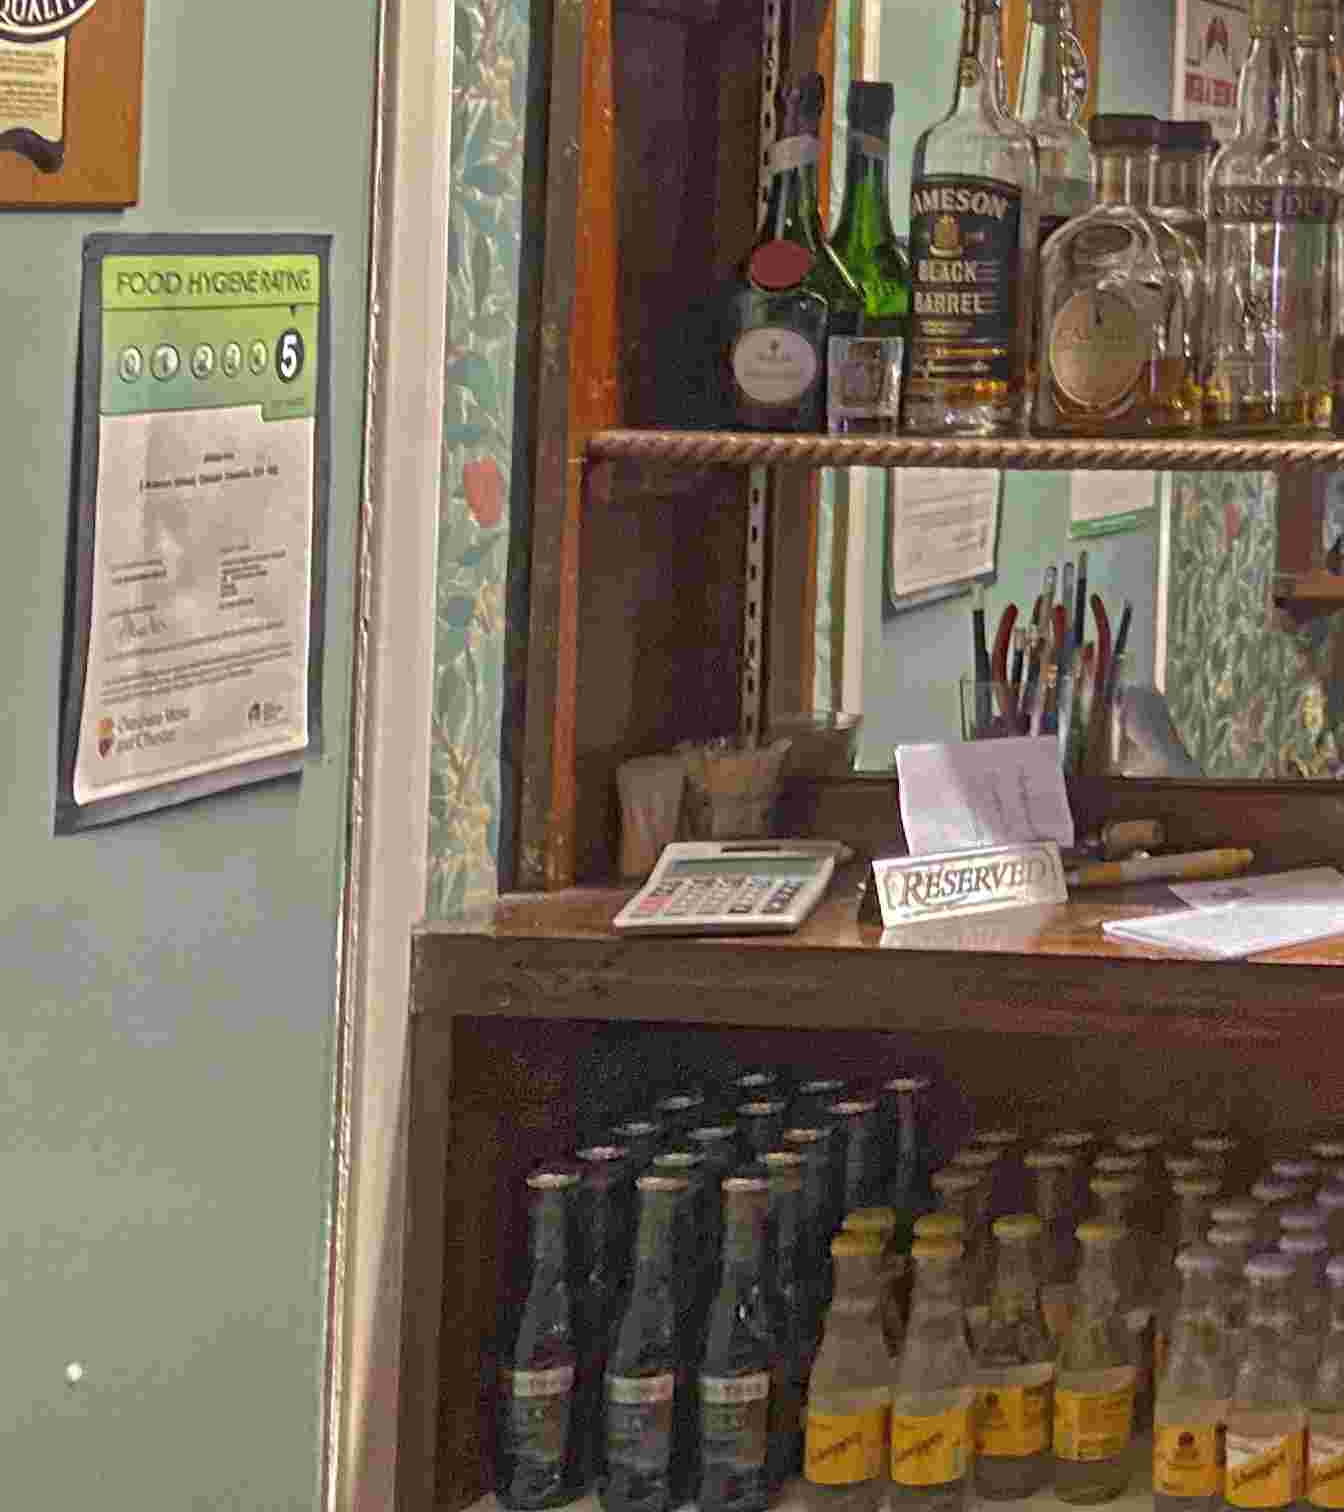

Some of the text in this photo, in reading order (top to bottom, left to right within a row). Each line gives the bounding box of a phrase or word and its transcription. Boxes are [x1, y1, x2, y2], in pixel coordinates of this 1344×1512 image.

[911, 188, 1012, 219] AMESON
[116, 271, 182, 295] FOOD
[918, 259, 977, 283] BLACK
[914, 292, 990, 315] BARREL
[280, 334, 299, 378] 5
[902, 858, 1052, 905] RESERVED
